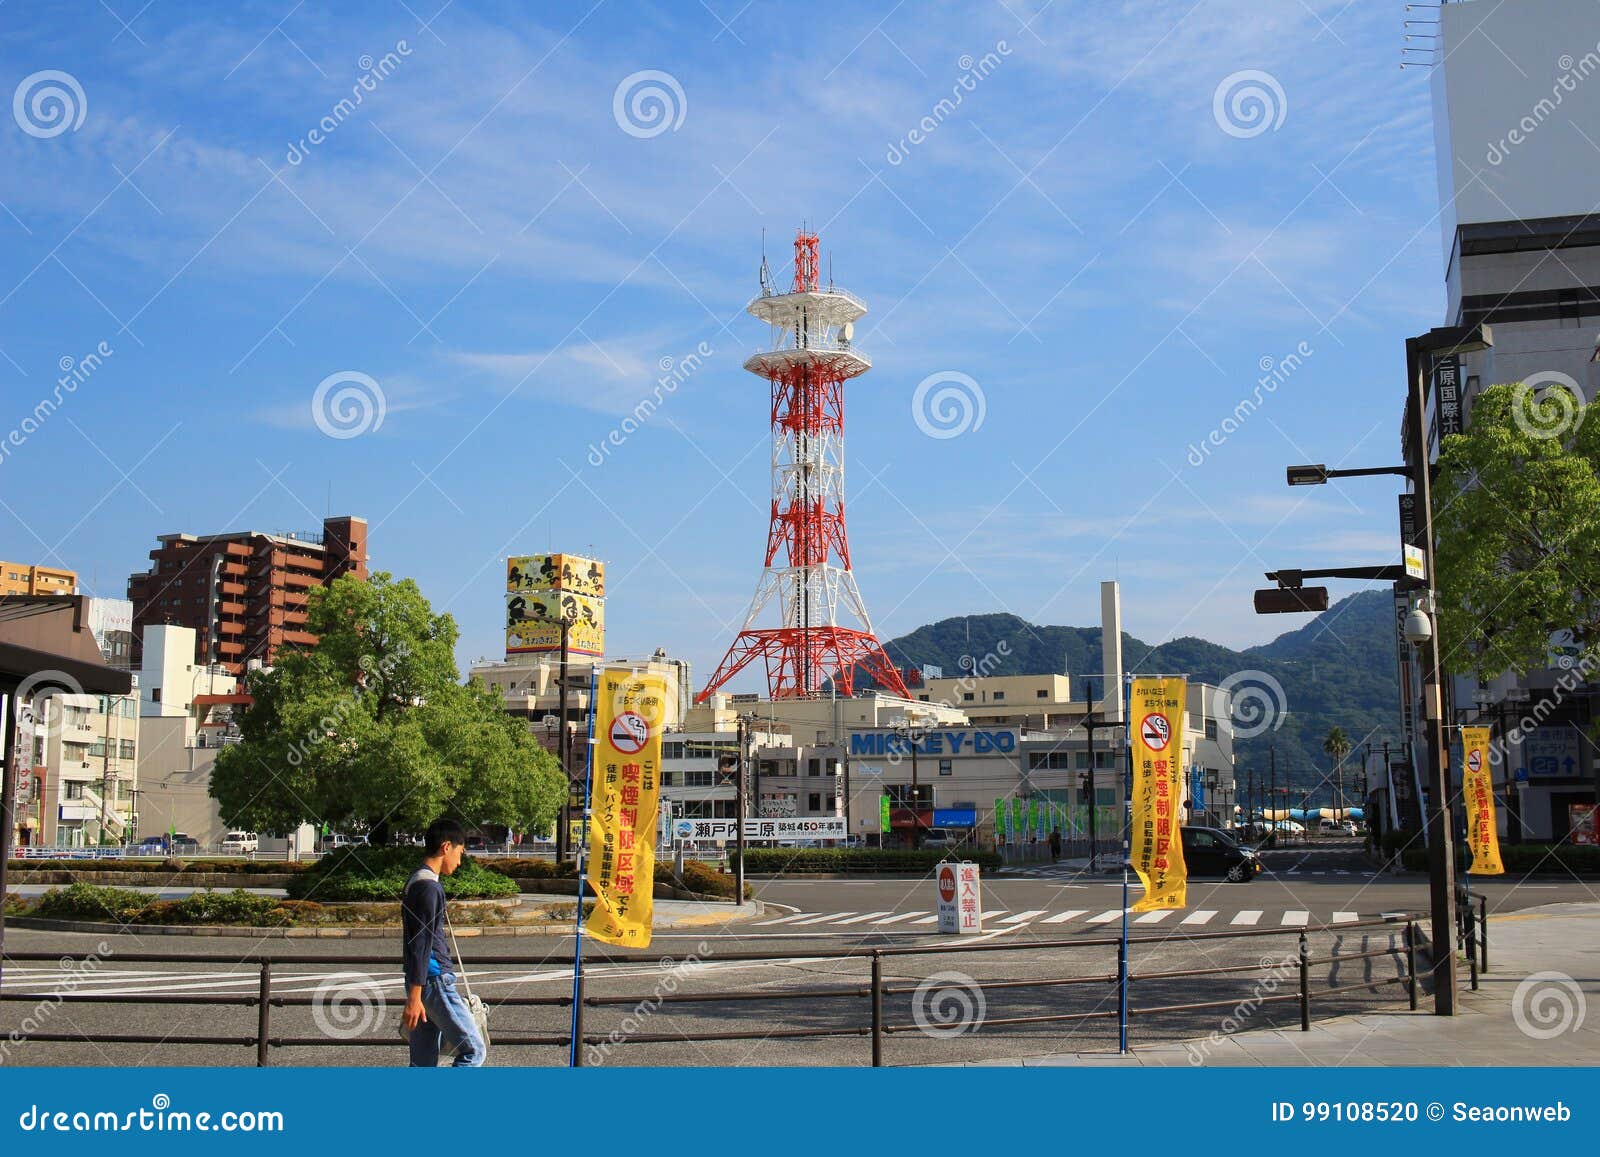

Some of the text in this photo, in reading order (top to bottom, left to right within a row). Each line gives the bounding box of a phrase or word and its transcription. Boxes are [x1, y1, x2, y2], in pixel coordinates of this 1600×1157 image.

[852, 731, 1015, 755] MICKEY-DO
[643, 761, 654, 790] ここは
[960, 868, 977, 928] 進入禁止
